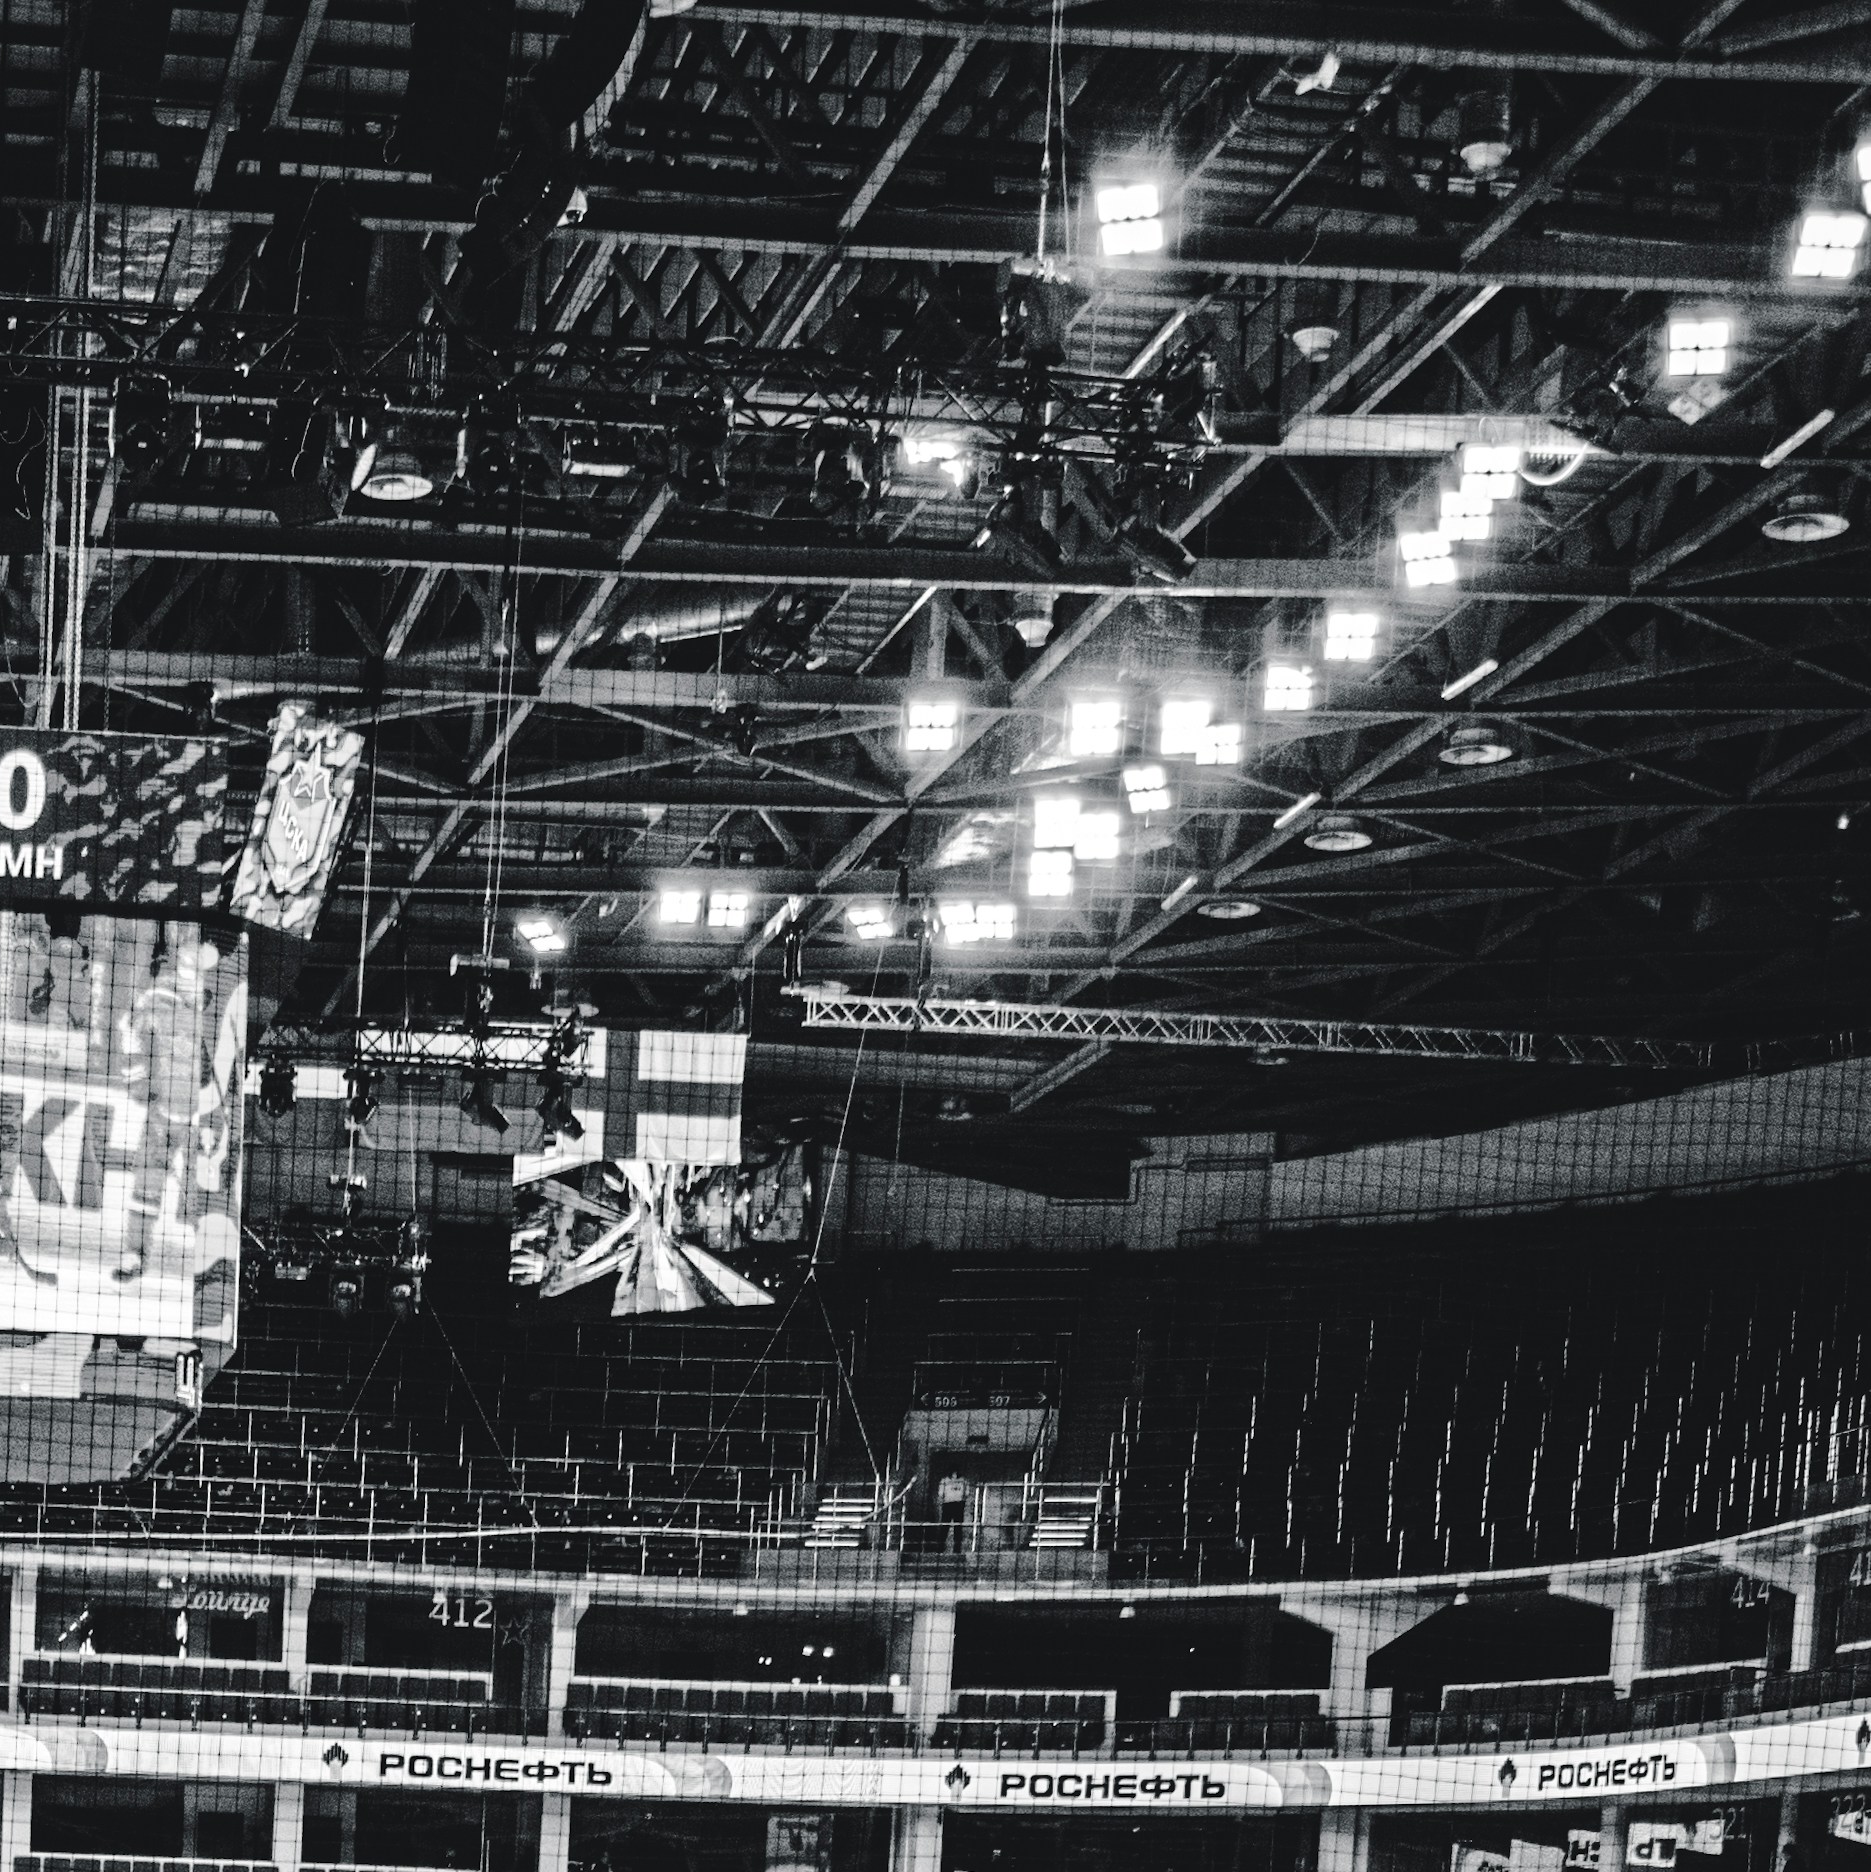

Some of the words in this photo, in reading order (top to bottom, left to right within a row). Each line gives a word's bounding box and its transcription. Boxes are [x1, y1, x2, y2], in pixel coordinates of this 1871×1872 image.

[278, 800, 308, 862] ЦСКА
[429, 1599, 494, 1630] 412
[380, 1752, 613, 1786] РОСНЕФТЬ
[1538, 1752, 1678, 1791] РОСНЕФТЬ
[999, 1774, 1227, 1800] РОСНЕФТЬ
